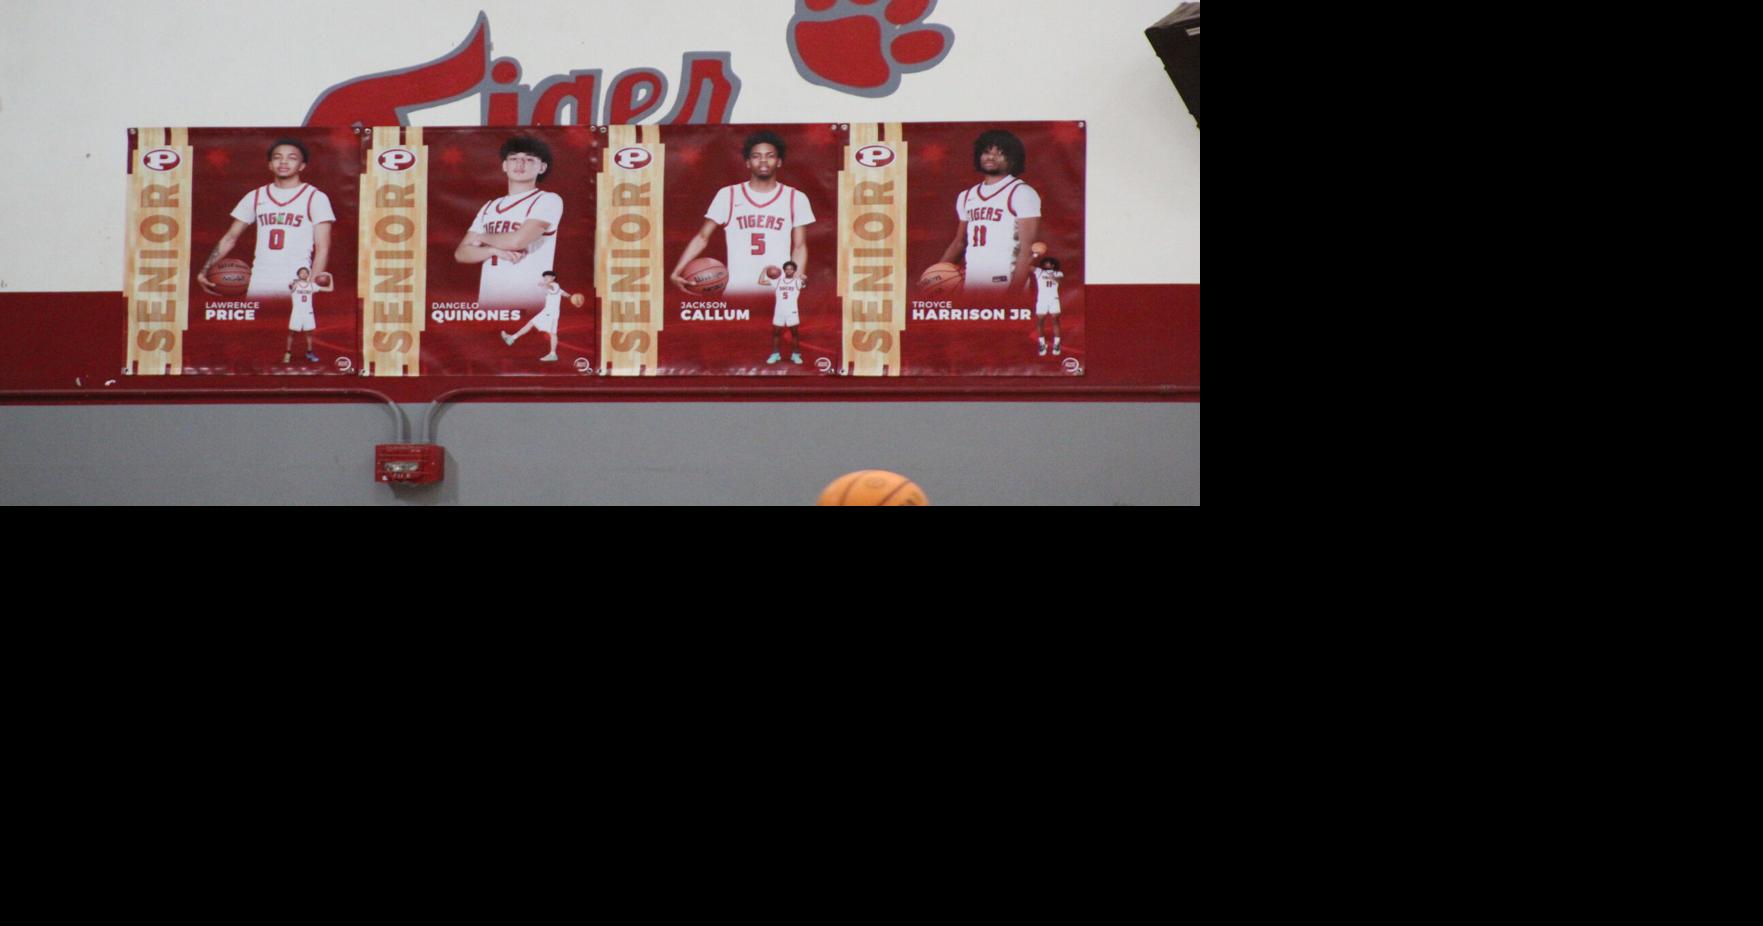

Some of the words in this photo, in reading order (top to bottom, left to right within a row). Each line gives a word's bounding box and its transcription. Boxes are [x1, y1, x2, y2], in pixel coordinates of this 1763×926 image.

[736, 214, 785, 230] TIGERS
[269, 229, 285, 250] 0
[751, 233, 766, 255] 5
[137, 183, 180, 353] SENIOR
[373, 183, 415, 353] SENIOR
[611, 182, 650, 353] SENIOR
[852, 180, 894, 353] SENIOR
[432, 302, 479, 310] DANGELO
[912, 301, 952, 309] TROYCE
[205, 310, 255, 320] PRICE
[431, 310, 521, 323] QUINONES
[681, 310, 750, 320] CALLUM
[912, 309, 1005, 320] HARRISON
[1010, 309, 1031, 320] JR
